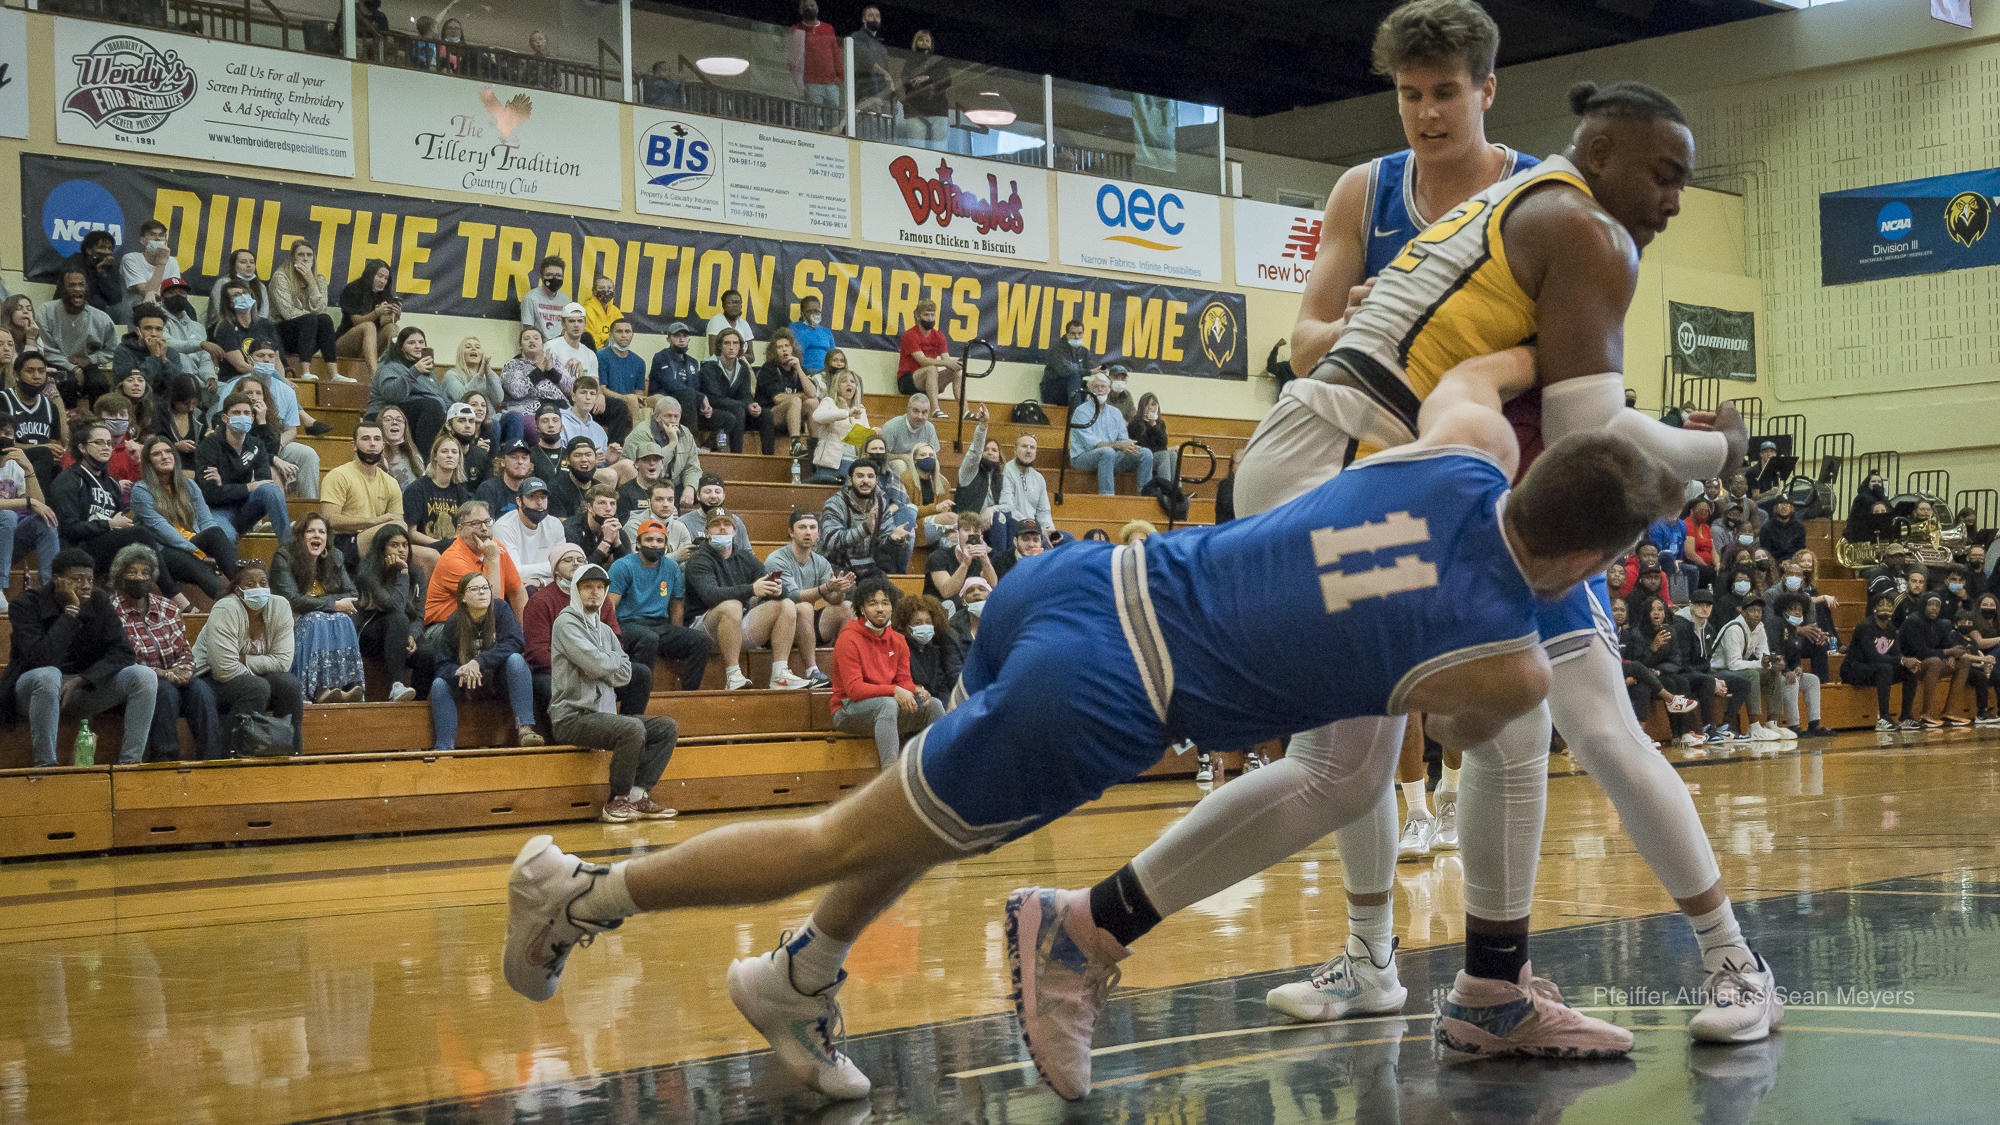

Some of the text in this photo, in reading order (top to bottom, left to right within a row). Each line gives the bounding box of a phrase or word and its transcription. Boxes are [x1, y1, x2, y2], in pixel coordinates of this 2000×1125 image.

[104, 40, 138, 54] EMBROIDERY
[73, 50, 185, 91] Wendy's
[226, 63, 325, 89] Call Us For all your
[128, 91, 185, 110] SPECIALTIES
[206, 79, 344, 113] Screen Printing, Embroidery
[112, 116, 133, 130] SCREEN
[222, 101, 331, 126] & Ad Specialty Needs
[450, 114, 484, 138] The
[115, 134, 132, 143] Est.
[414, 132, 581, 177] Tillery Tradition
[646, 134, 710, 172] BIS
[462, 171, 538, 195] Country Club
[640, 190, 664, 200] Property
[670, 193, 693, 203] Casualty
[694, 197, 720, 206] Insurance
[1096, 183, 1185, 236] aec
[1880, 217, 1912, 233] NCAA
[899, 229, 933, 245] Famous
[935, 234, 969, 249] Chicken
[981, 240, 1016, 254] Biscuits
[1872, 239, 1919, 256] Division III
[1081, 253, 1108, 266] Narrow
[1139, 260, 1161, 272] Infinite
[1258, 262, 1291, 282] new
[457, 220, 775, 324] TRADITION
[789, 259, 983, 343] STARTS
[997, 281, 1120, 355] WITH
[1121, 296, 1189, 362] ME
[1697, 334, 1749, 352] WARRIOR
[1309, 510, 1439, 615] 11
